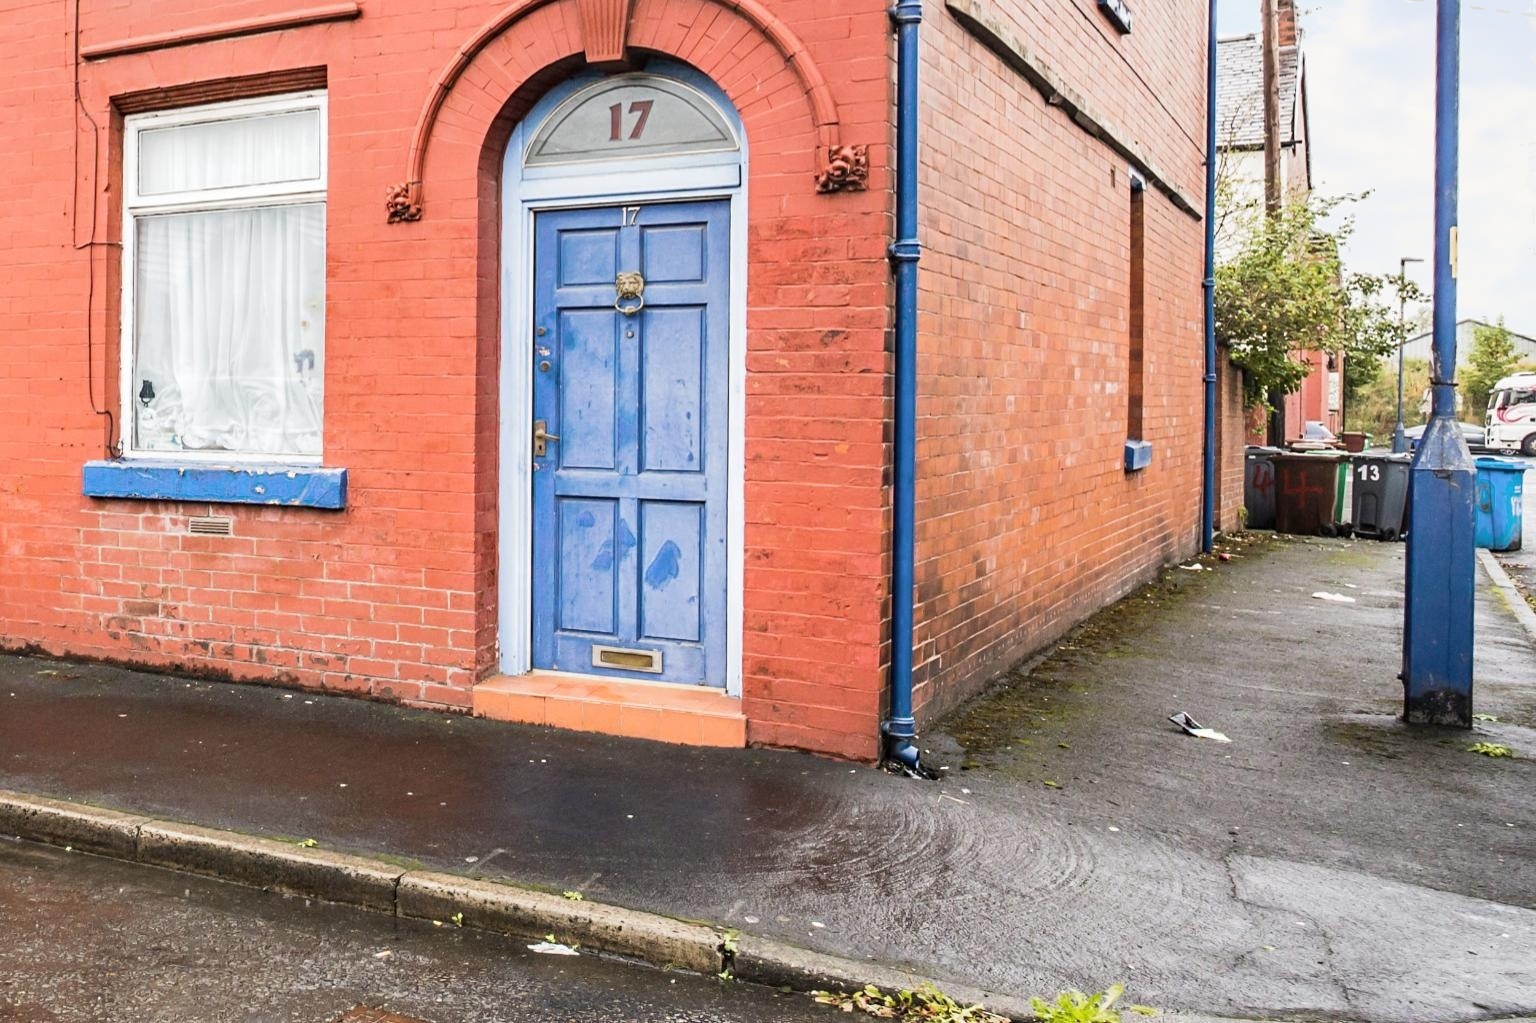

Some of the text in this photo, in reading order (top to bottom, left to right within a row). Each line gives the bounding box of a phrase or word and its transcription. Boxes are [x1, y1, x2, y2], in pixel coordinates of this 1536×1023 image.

[609, 100, 654, 141] 17
[622, 206, 641, 226] 17
[1357, 464, 1380, 481] 13
[1282, 470, 1324, 509] 4
